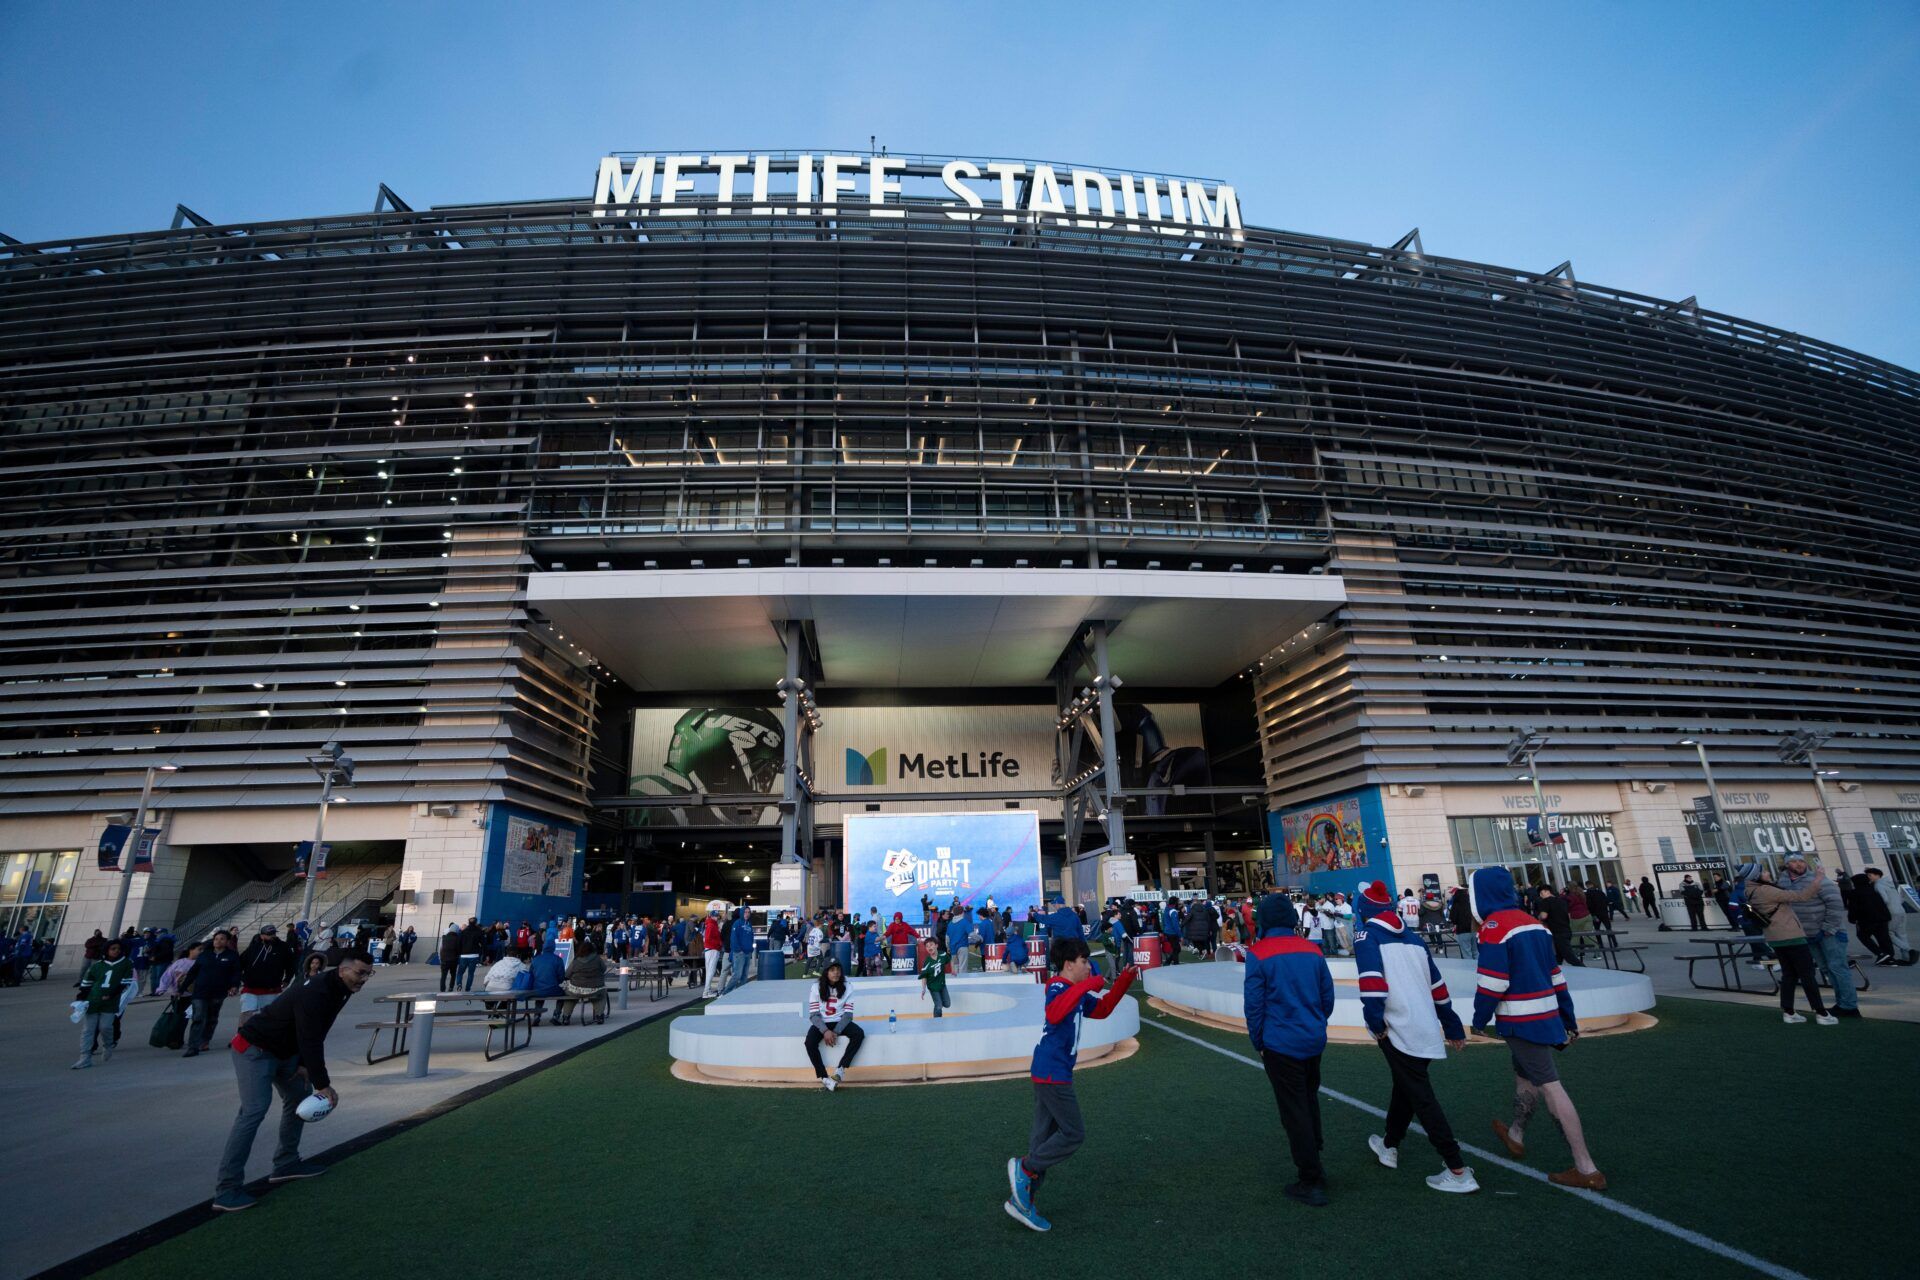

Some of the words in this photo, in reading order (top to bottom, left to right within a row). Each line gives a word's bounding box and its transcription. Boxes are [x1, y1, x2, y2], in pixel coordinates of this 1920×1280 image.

[594, 155, 906, 217] METLIFE
[942, 160, 1244, 241] STADIUM
[704, 714, 782, 748] JETS
[899, 752, 1020, 779] MetLife
[1502, 795, 1538, 808] WEST
[1722, 792, 1752, 805] WEST
[1752, 792, 1770, 804] VIP
[1497, 815, 1528, 830] WES
[1557, 831, 1618, 859] LUB
[1753, 827, 1815, 853] CLUB
[917, 859, 971, 885] DRAFT
[1655, 864, 1683, 872] GUEST
[1684, 862, 1726, 870] SERVICES
[930, 879, 958, 888] PARTY
[1406, 904, 1417, 916] 10
[634, 930, 641, 940] 5
[101, 970, 113, 988] 1
[825, 999, 838, 1016] 5
